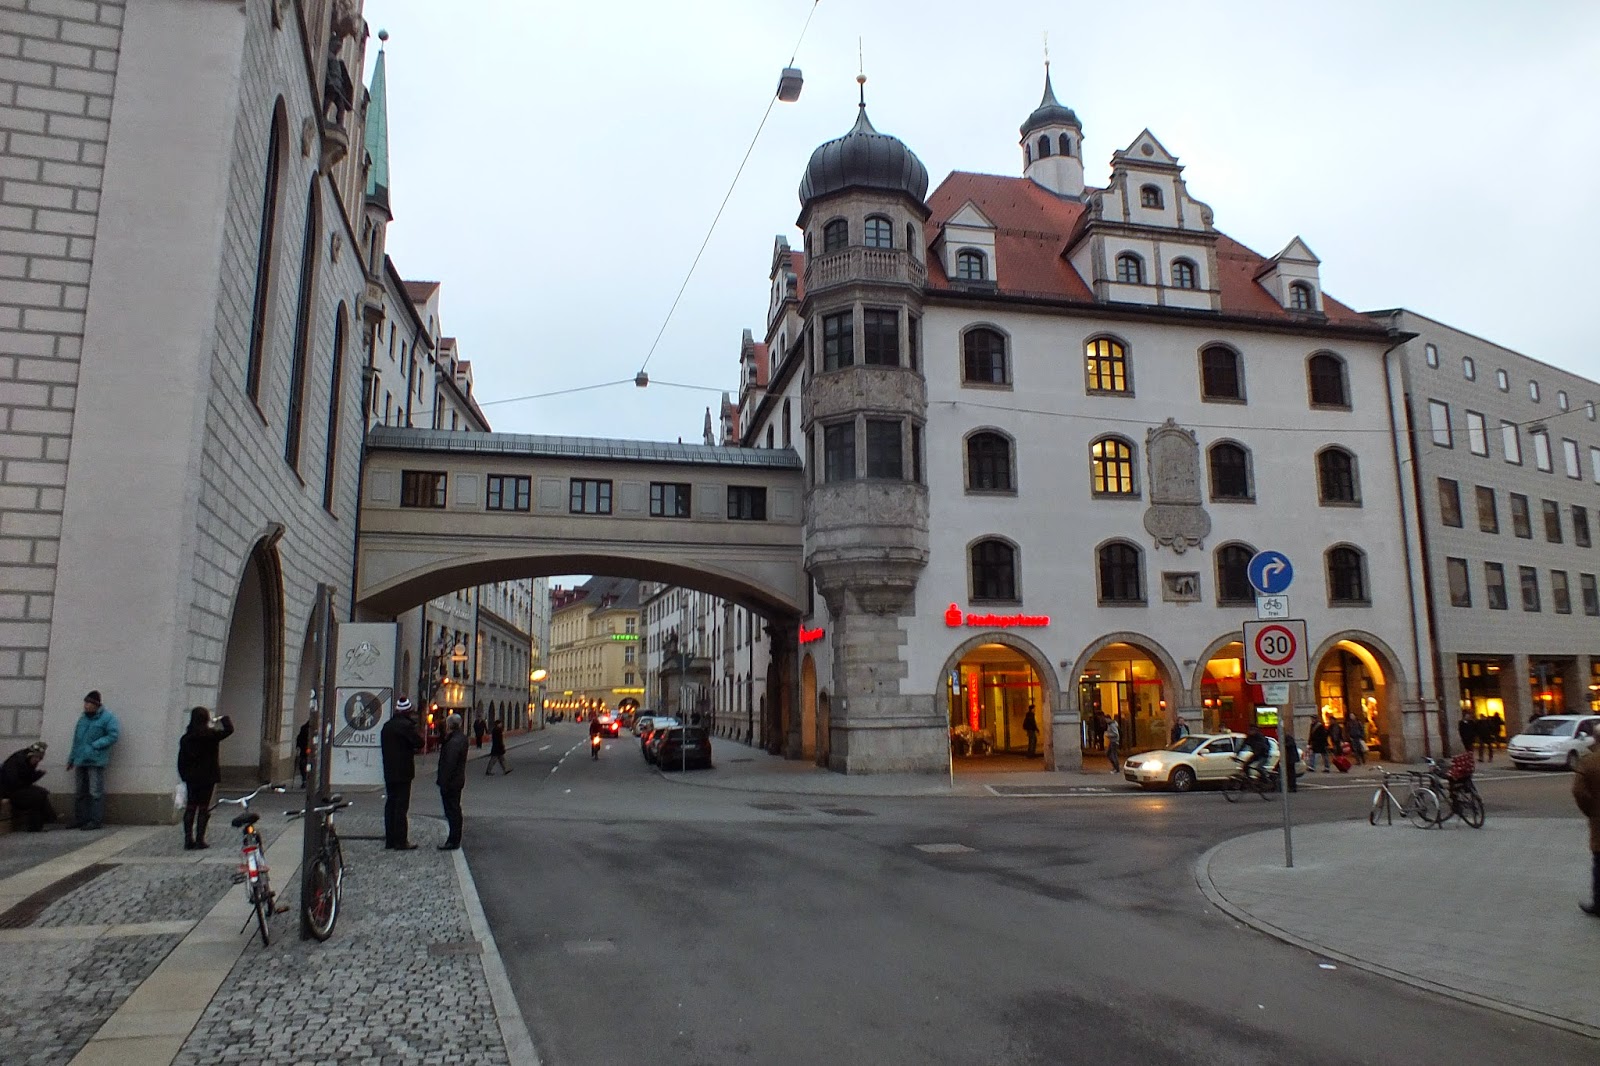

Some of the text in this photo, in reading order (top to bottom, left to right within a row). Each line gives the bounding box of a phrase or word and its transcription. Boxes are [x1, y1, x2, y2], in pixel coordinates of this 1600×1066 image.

[1263, 636, 1288, 654] 30
[1262, 668, 1294, 679] ZONE
[347, 733, 377, 744] ZONE
